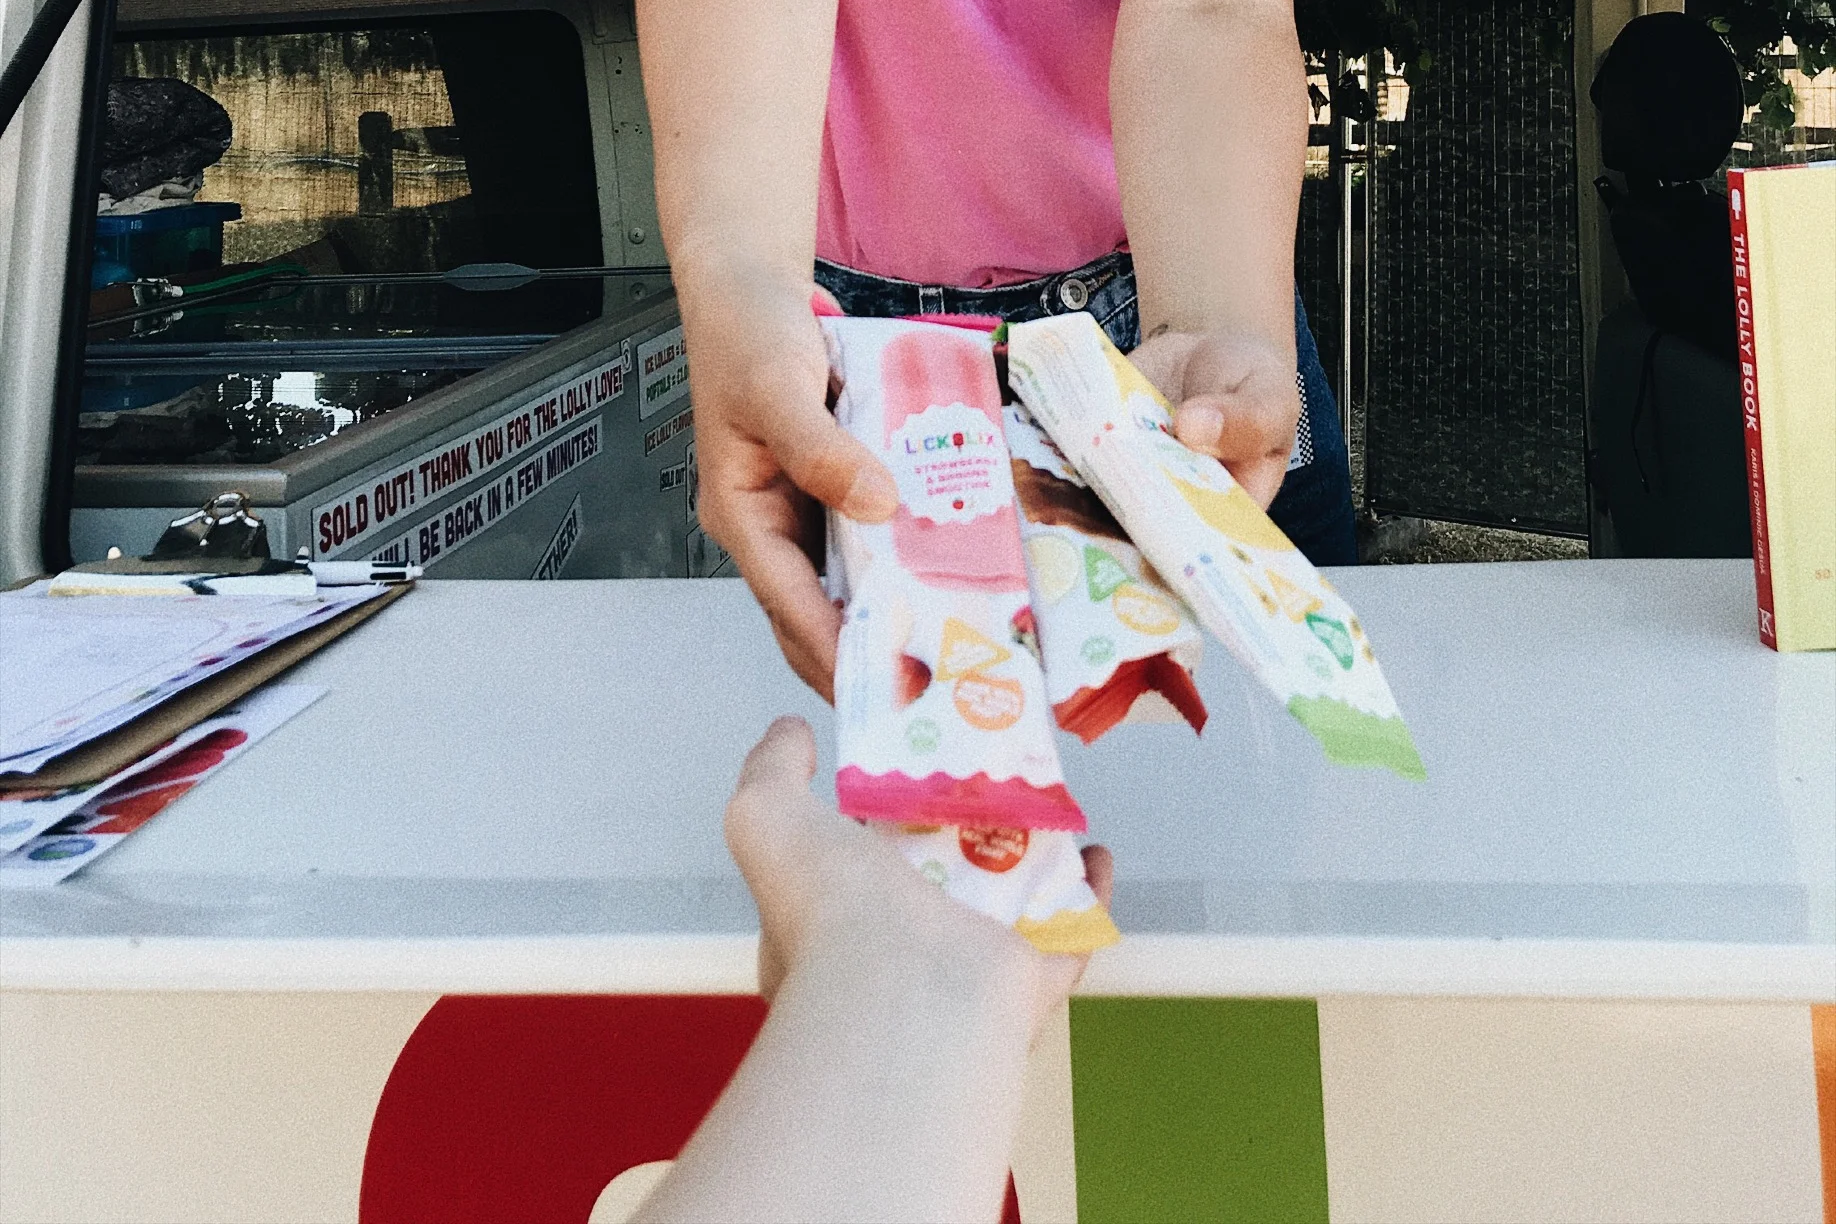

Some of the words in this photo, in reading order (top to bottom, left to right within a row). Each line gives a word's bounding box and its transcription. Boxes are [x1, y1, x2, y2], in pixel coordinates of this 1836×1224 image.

[1733, 232, 1747, 279] THE
[1736, 285, 1752, 357] LOLLY
[1742, 361, 1758, 432] BOOK
[318, 493, 369, 554] SOLD
[374, 468, 415, 523] OUT!
[418, 440, 473, 498] THANK
[475, 426, 504, 470] YOU
[506, 412, 533, 454] FOR
[533, 397, 559, 437] THE
[559, 378, 593, 423] LOLLY
[594, 364, 623, 404] LOVE!
[418, 519, 441, 565] BE
[444, 494, 485, 549] BACK
[487, 483, 501, 522] IN
[505, 475, 514, 510] A
[517, 455, 544, 502] FEW
[546, 423, 598, 481] MINUTES!
[1758, 607, 1774, 638] K
